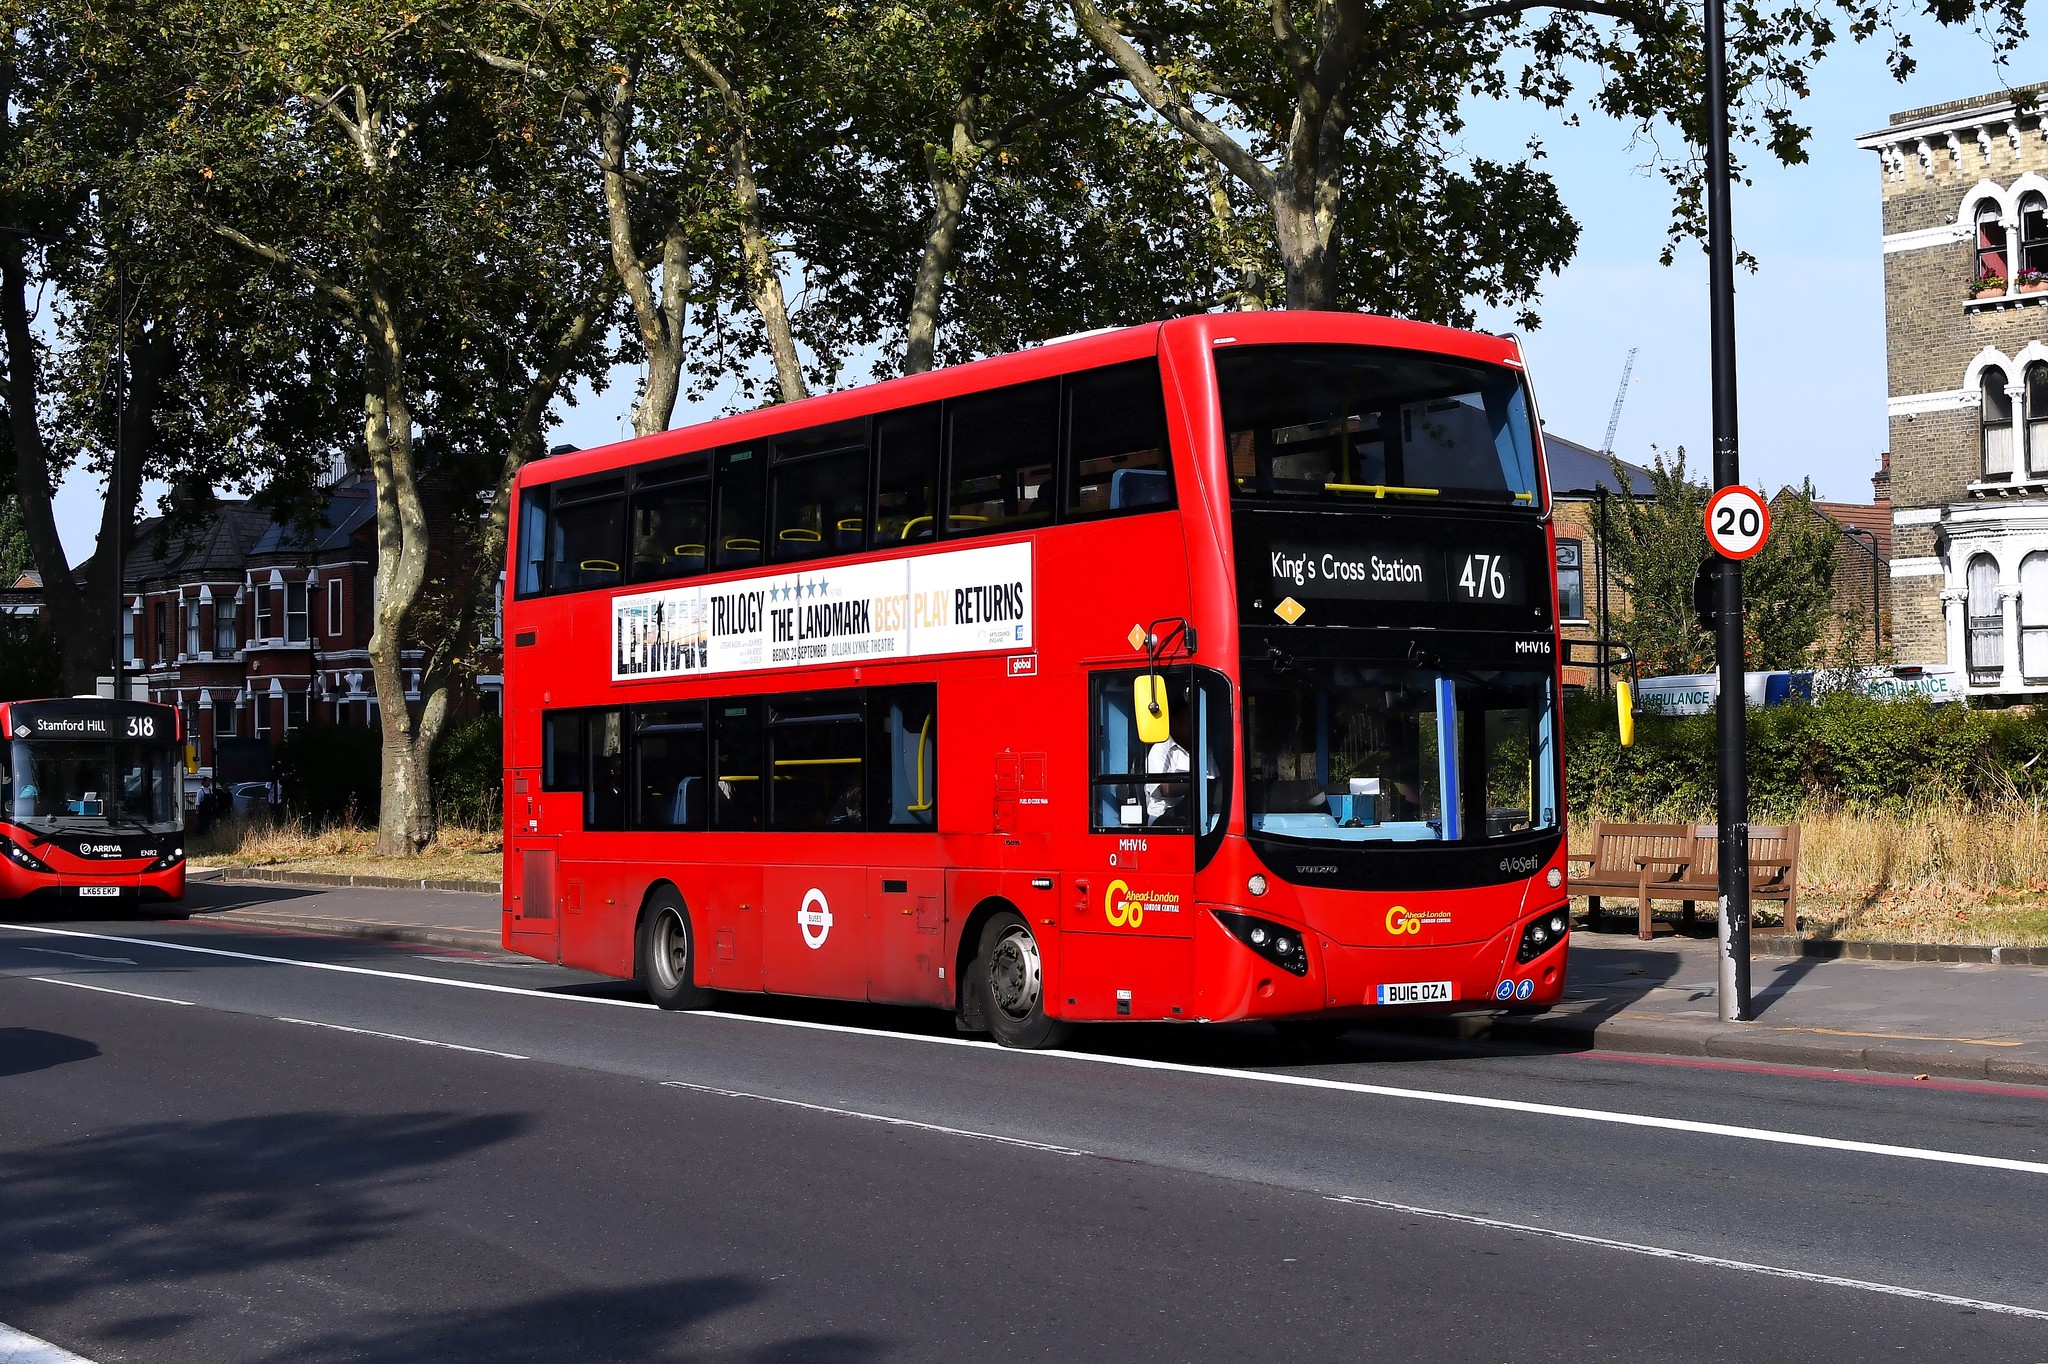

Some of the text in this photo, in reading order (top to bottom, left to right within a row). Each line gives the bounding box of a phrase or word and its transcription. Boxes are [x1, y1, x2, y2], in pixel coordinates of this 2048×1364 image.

[1717, 507, 1760, 537] 20
[1271, 552, 1423, 586] King's Cross Station
[1458, 554, 1506, 599] 476
[711, 591, 765, 637] TRILOGY
[770, 581, 1024, 643] THE LANDMARK BEST PLAY RETURNS
[772, 647, 790, 662] BEGINS
[797, 644, 827, 659] SEPTEMBER
[831, 642, 851, 656] GILLIAN
[852, 640, 869, 654] LYNNE
[871, 638, 895, 652] THEATRE
[1515, 640, 1551, 654] MHV16
[1013, 658, 1032, 674] global
[37, 718, 106, 732] Stamford Hill
[126, 716, 154, 737] 318
[92, 844, 122, 853] ARRIVA
[140, 849, 158, 857] ENR2
[1119, 839, 1147, 851] MHV16
[1109, 853, 1117, 866] Q
[1500, 854, 1538, 873] eVoSeti
[1295, 865, 1339, 874] VOLVO
[102, 887, 117, 895] EKP
[1105, 879, 1179, 928] Go Ahead-London
[1143, 902, 1180, 913] LONDON CENTRAL
[808, 914, 822, 923] BUSES
[1385, 905, 1451, 935] Go Ahead-London
[1389, 984, 1447, 1001] BU16 OZA
